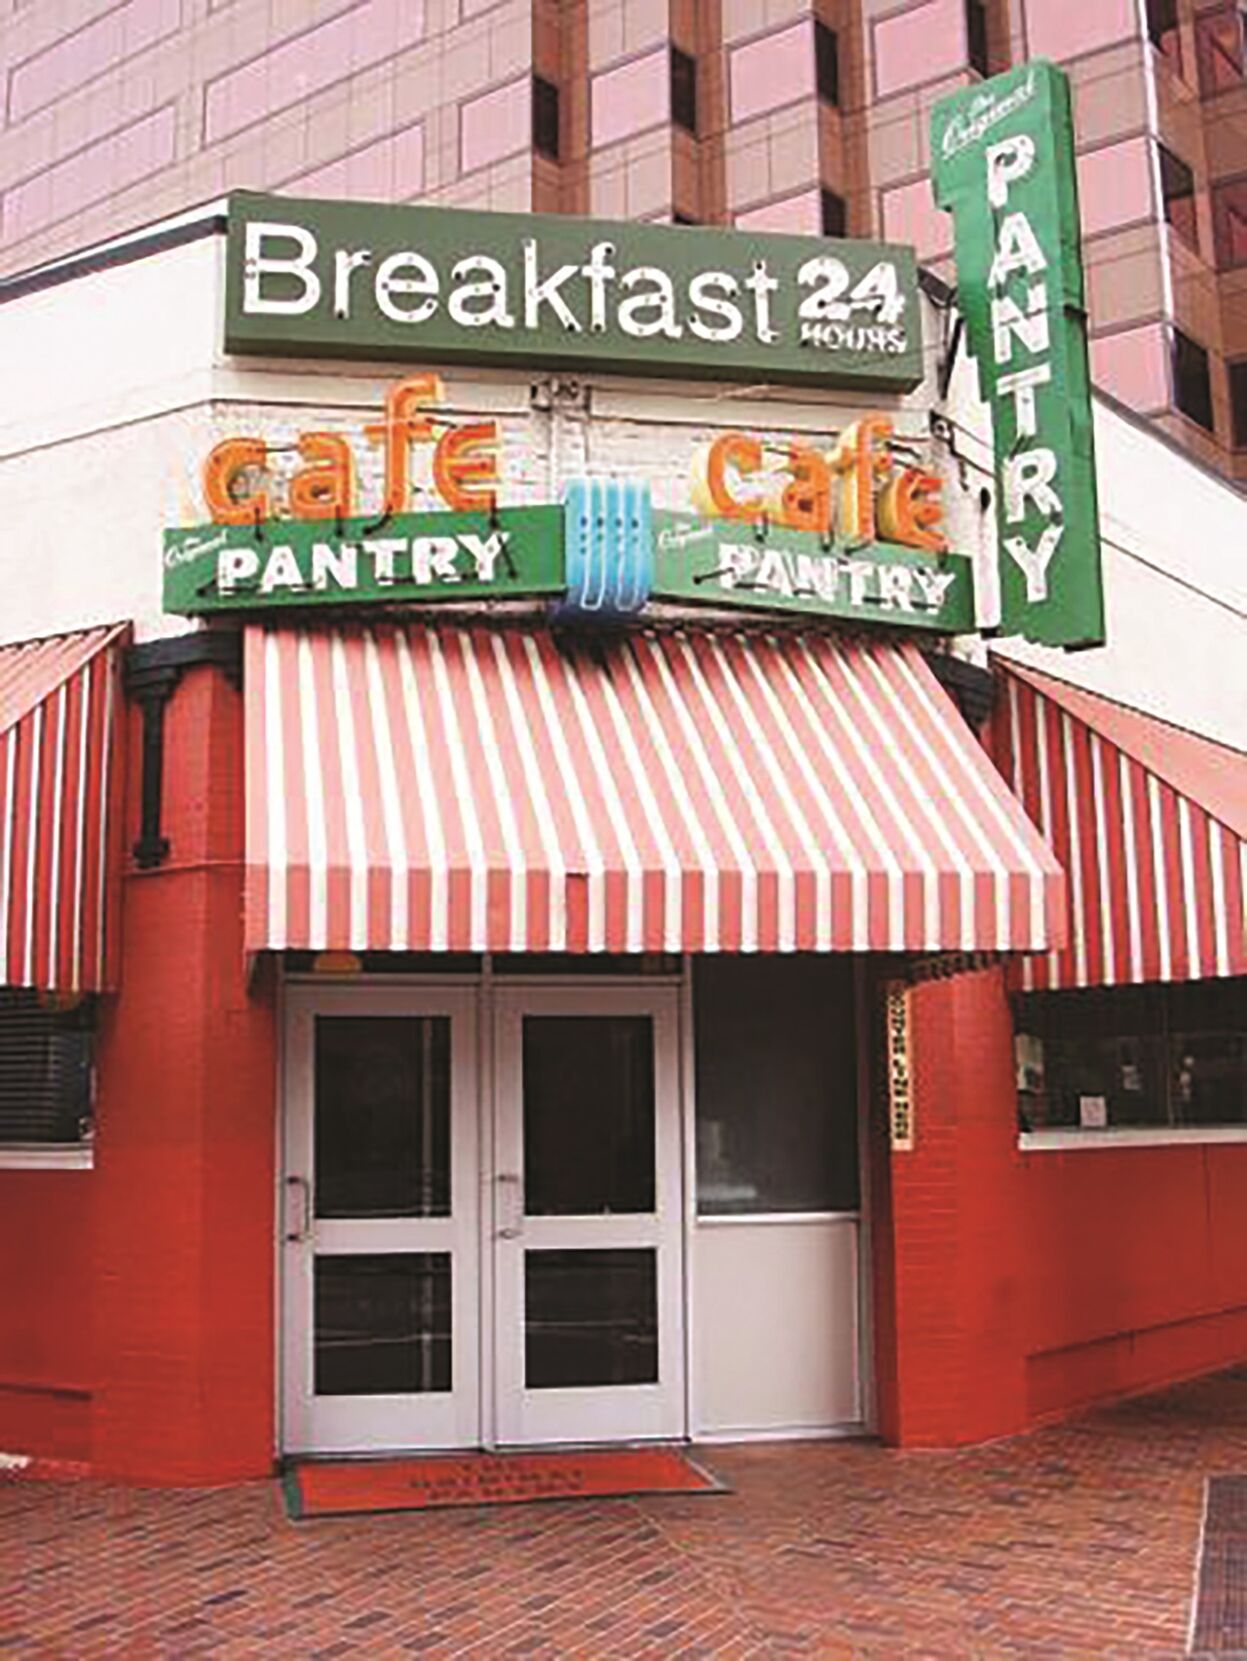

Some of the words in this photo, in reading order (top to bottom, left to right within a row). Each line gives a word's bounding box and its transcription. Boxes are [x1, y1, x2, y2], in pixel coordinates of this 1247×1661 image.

[243, 221, 778, 344] Breakfast
[798, 257, 905, 323] 24
[801, 322, 907, 353] HOURS
[985, 134, 1064, 602] PANTRY
[203, 373, 497, 526] cafe
[218, 532, 511, 597] PANTRY
[718, 543, 955, 614] PANTRY
